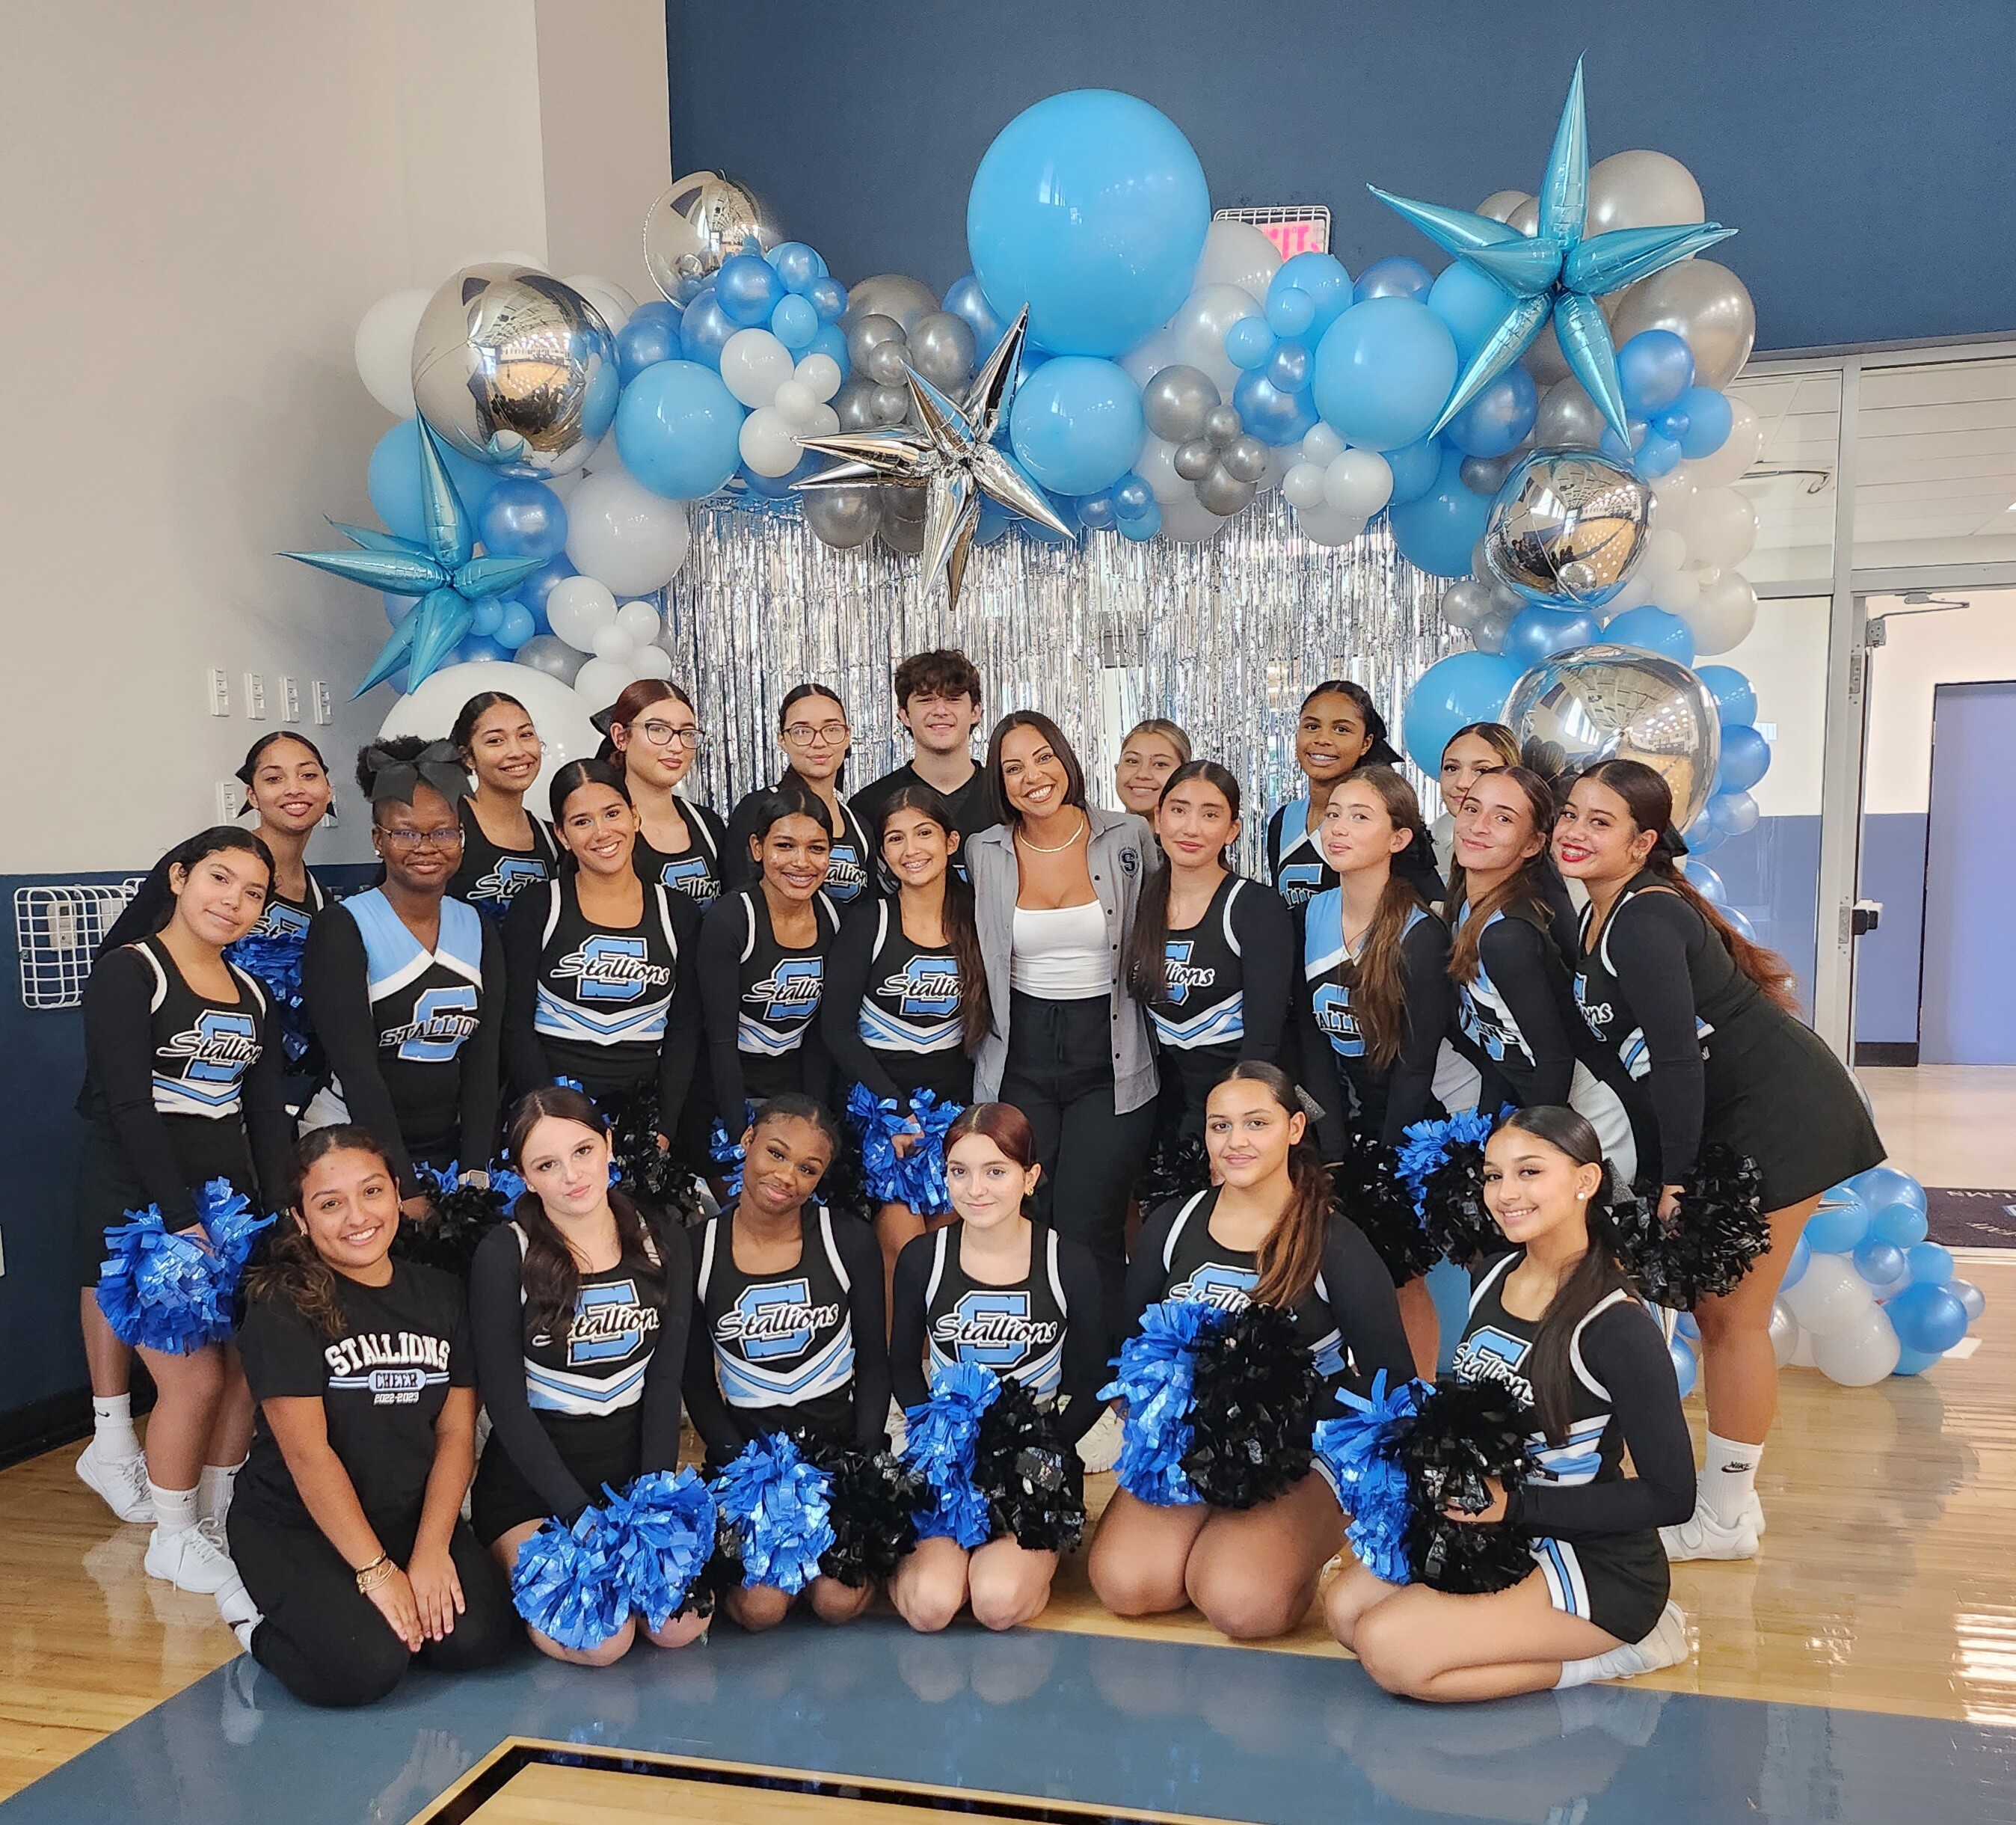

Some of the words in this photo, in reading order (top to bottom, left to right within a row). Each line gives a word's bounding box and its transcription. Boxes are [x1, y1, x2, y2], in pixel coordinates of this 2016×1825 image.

[550, 951, 671, 985] Stallions
[742, 978, 823, 1002] Stallio
[876, 973, 965, 998] Stallio
[156, 1029, 263, 1066] Stallion
[378, 1013, 481, 1048] STALLIO
[531, 1306, 662, 1347] tallion
[715, 1303, 840, 1343] Stallions
[932, 1312, 1058, 1345] Stallions
[325, 1331, 451, 1377] STALLIONS
[375, 1372, 419, 1390] CHEER
[374, 1391, 420, 1406] 2022-2023
